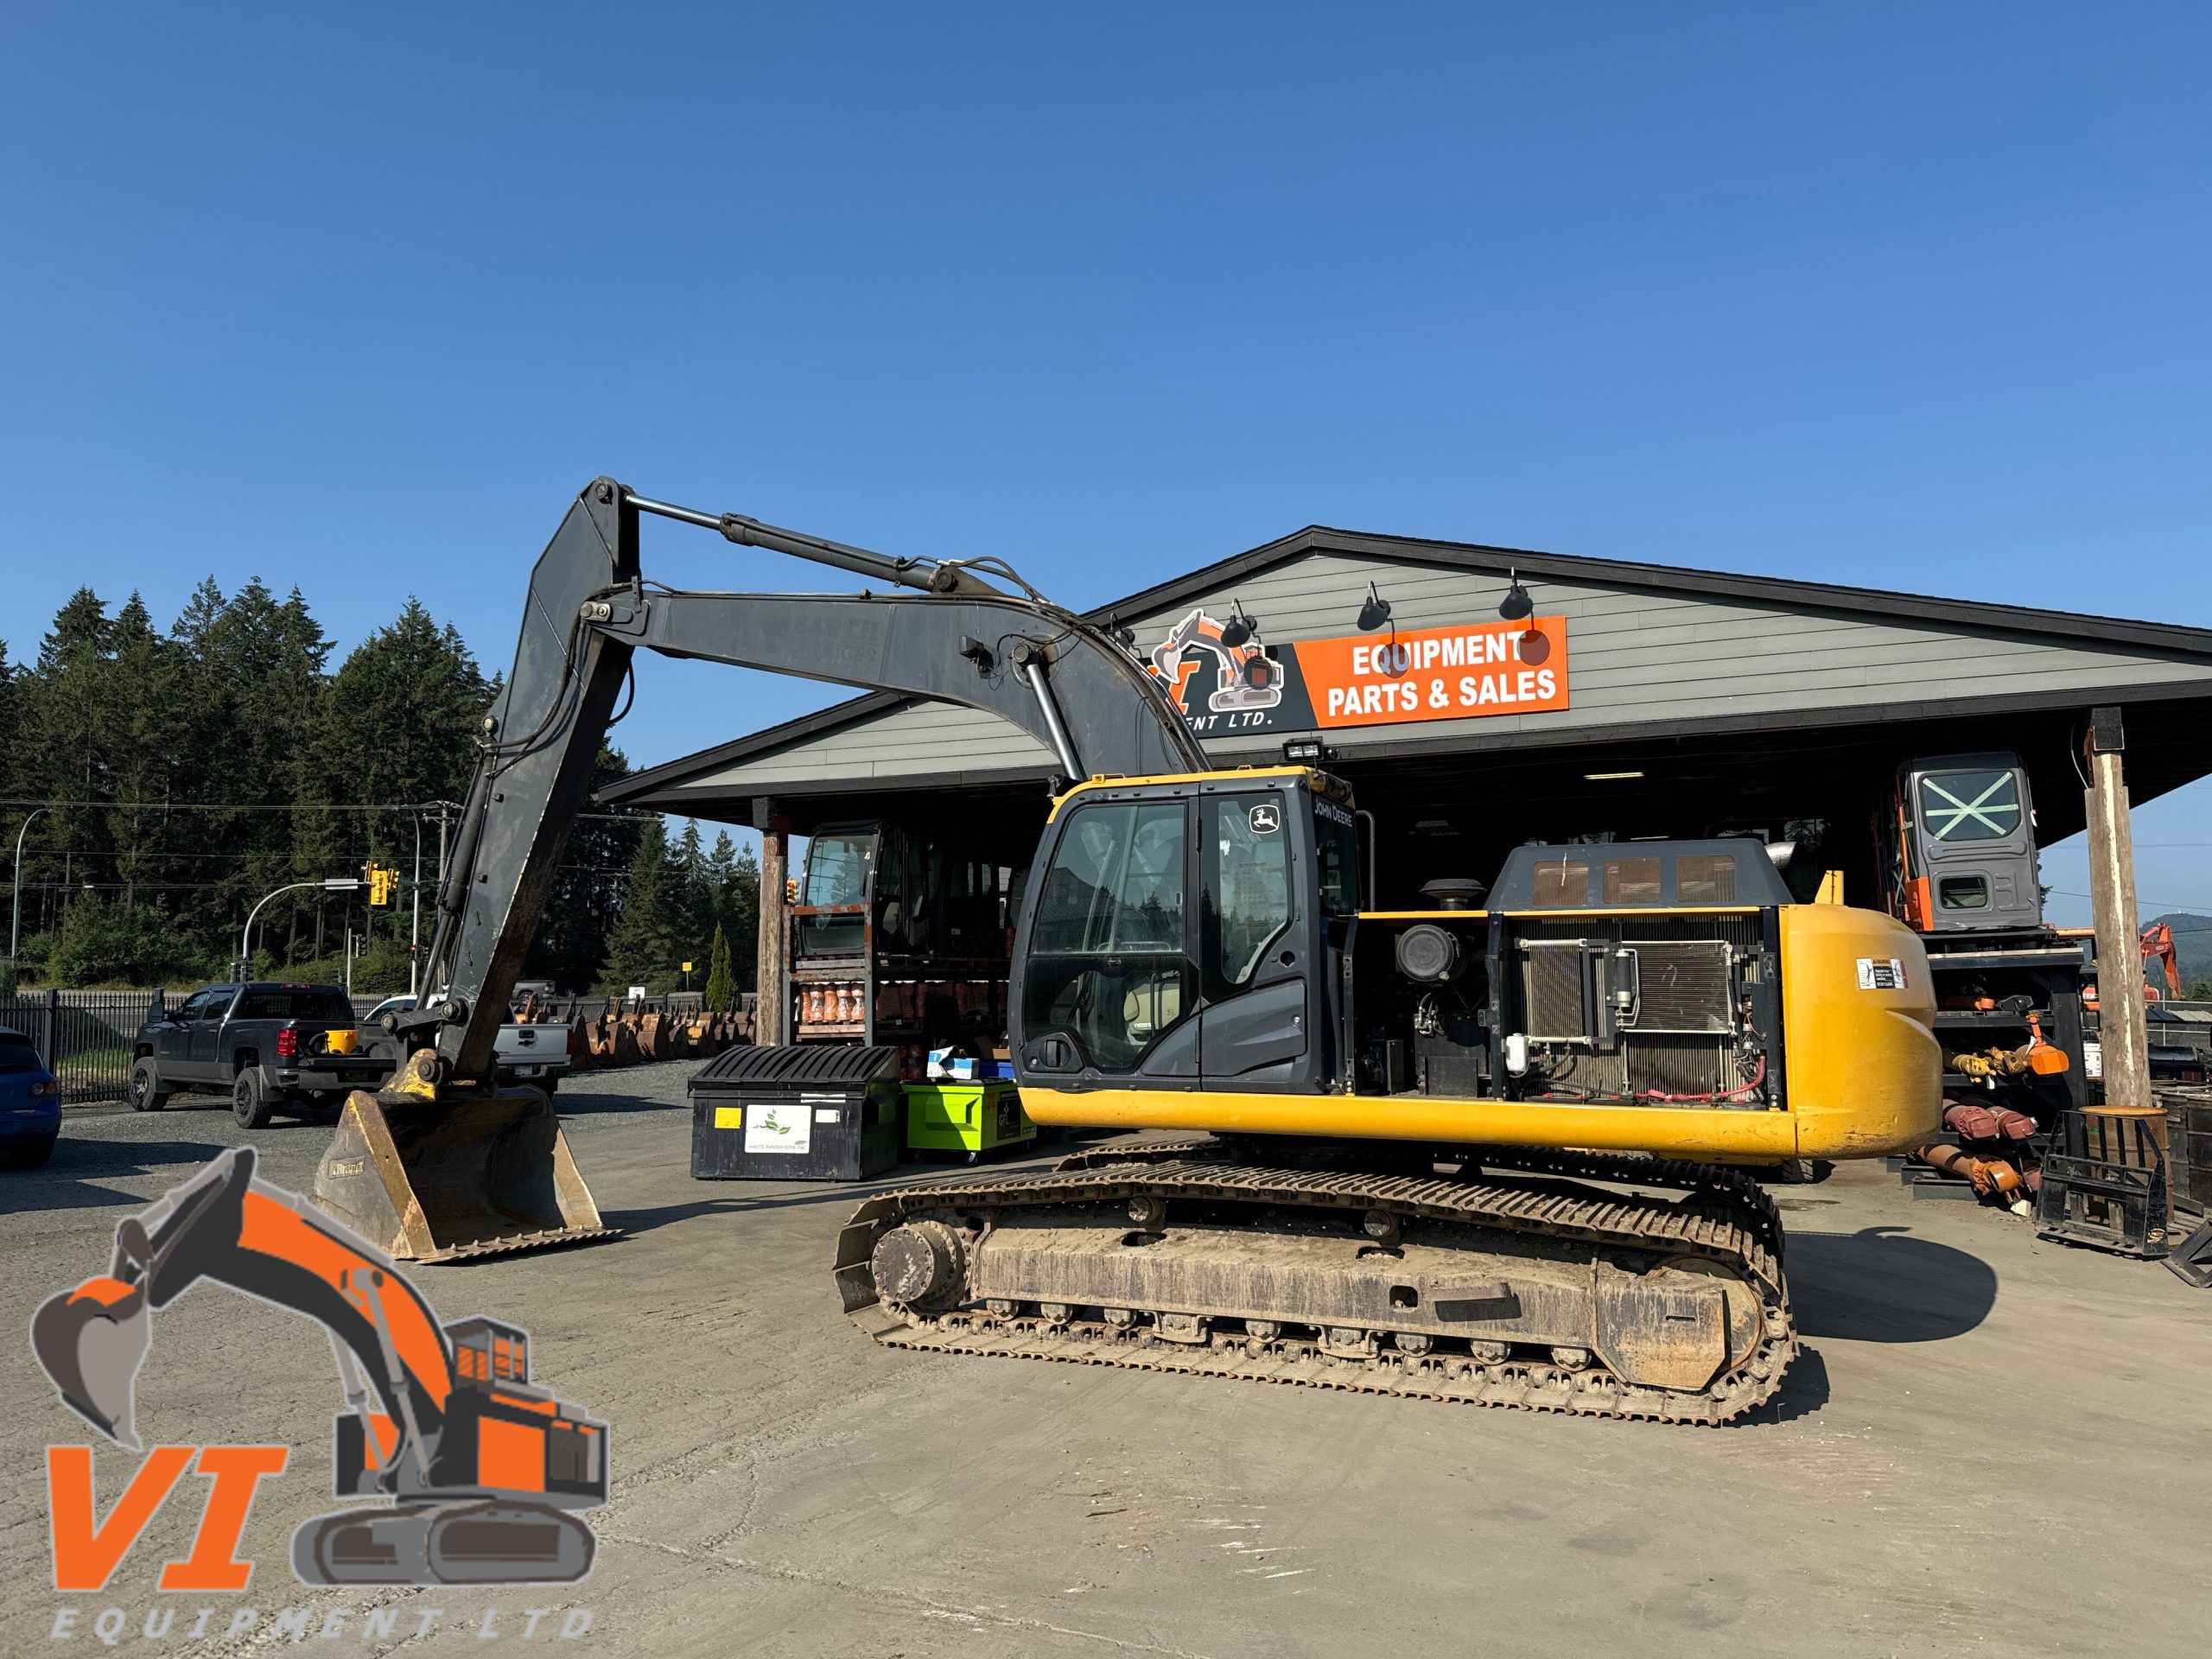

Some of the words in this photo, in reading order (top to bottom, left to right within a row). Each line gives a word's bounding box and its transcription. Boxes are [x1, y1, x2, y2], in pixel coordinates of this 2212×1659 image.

[1352, 631, 1526, 676] EQUIPMENT
[1328, 681, 1418, 717] PARTS
[1428, 678, 1450, 709] &
[1459, 669, 1556, 707] SALES
[1228, 711, 1272, 728] LTD.
[1315, 798, 1332, 819] JOHN
[1332, 804, 1352, 828] DEERE
